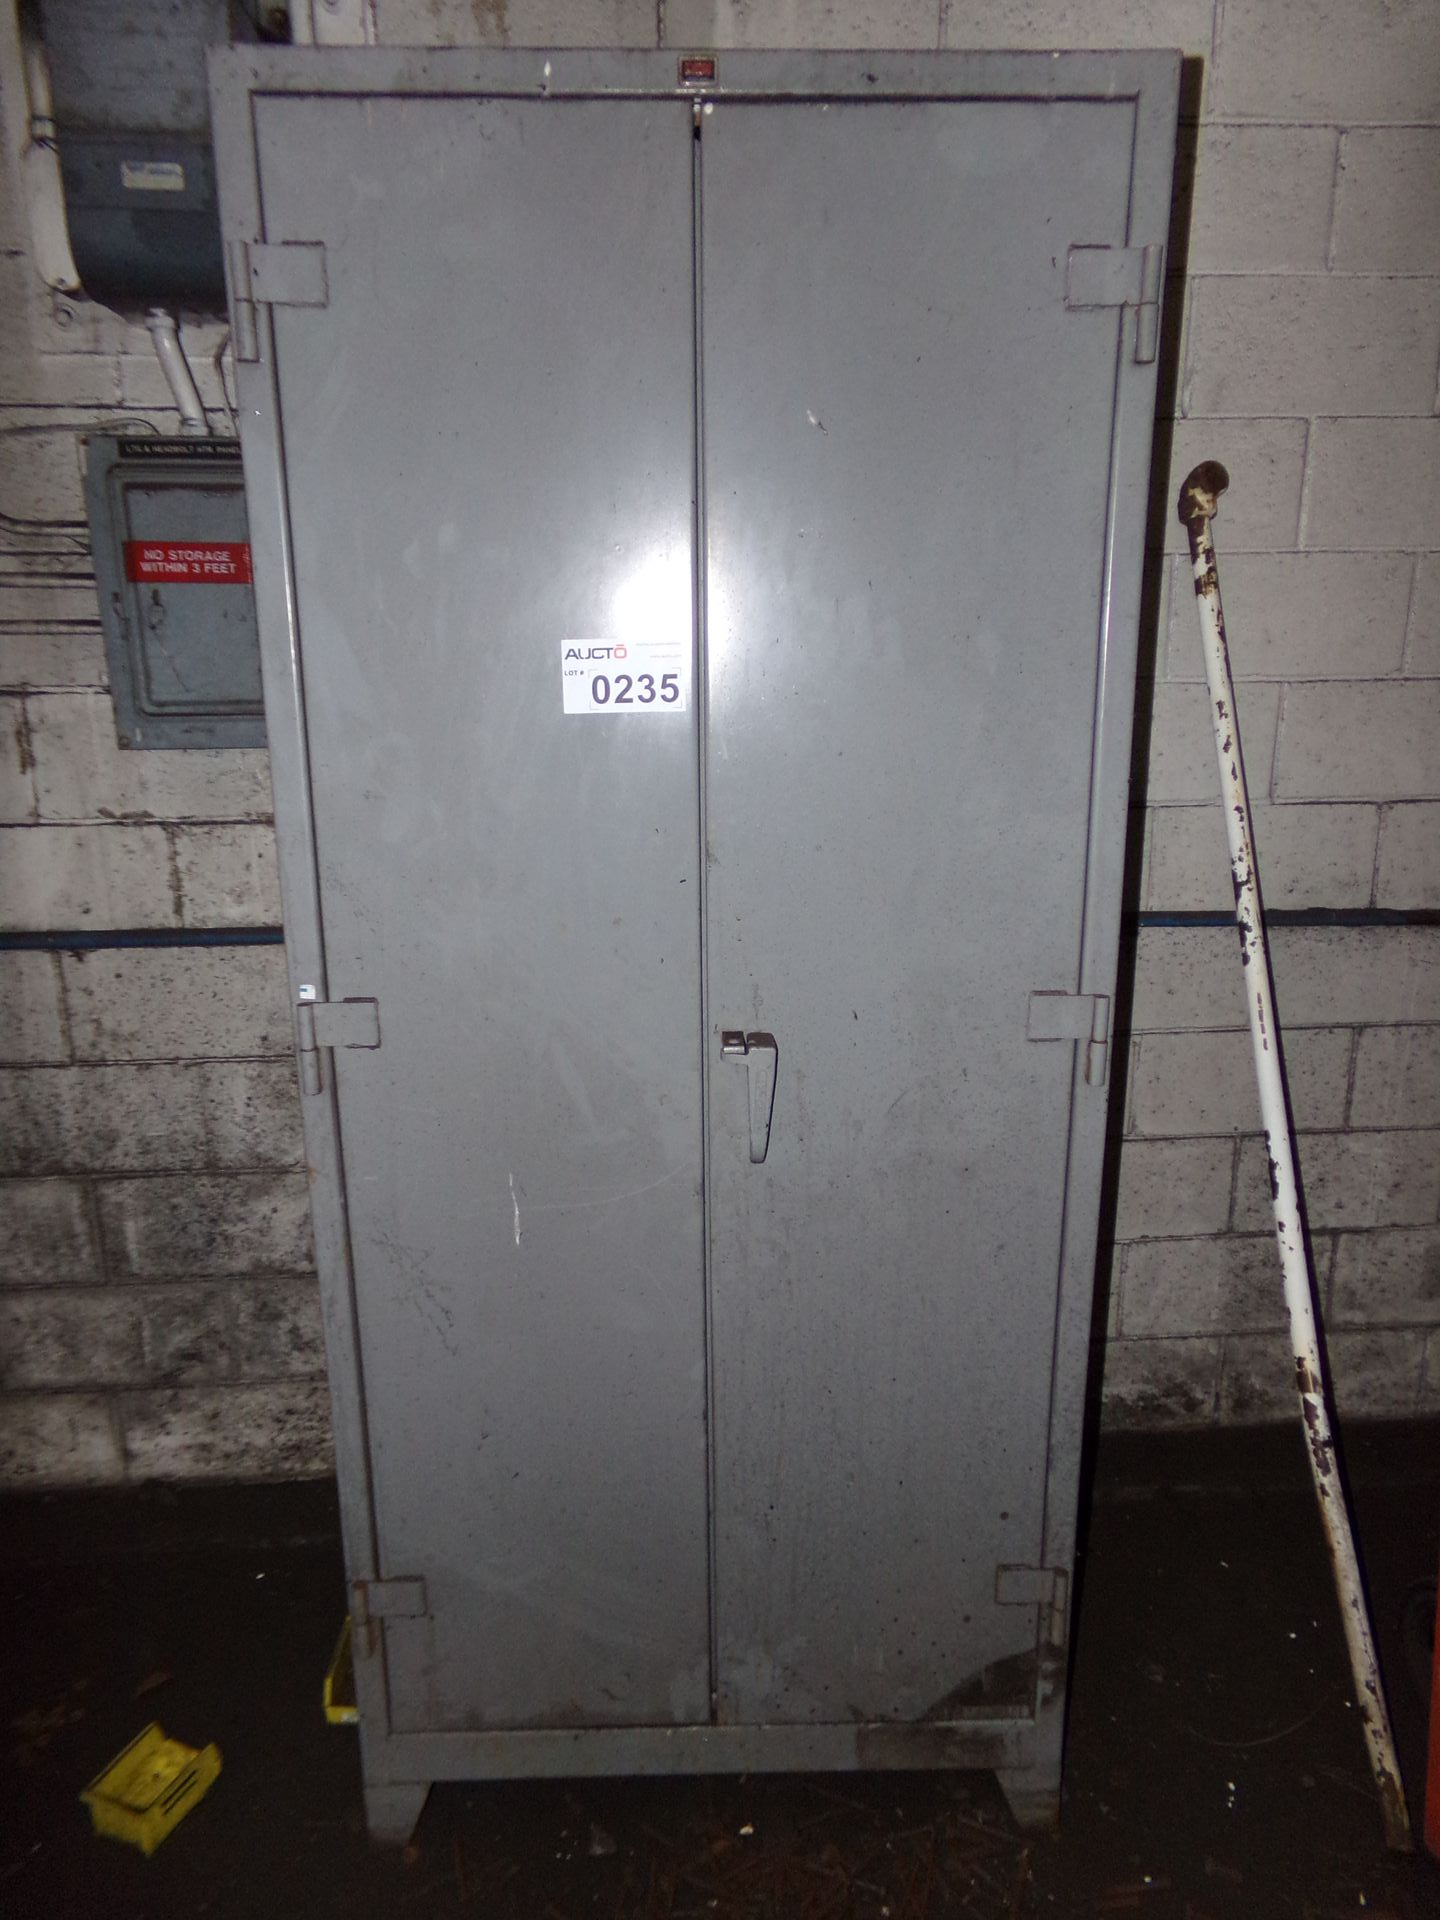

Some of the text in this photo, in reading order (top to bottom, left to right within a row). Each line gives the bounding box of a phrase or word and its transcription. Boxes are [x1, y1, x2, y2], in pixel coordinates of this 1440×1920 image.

[143, 549, 231, 561] NO STORAGE
[140, 561, 237, 573] WITHIN 3 FEET
[591, 673, 680, 705] 0235
